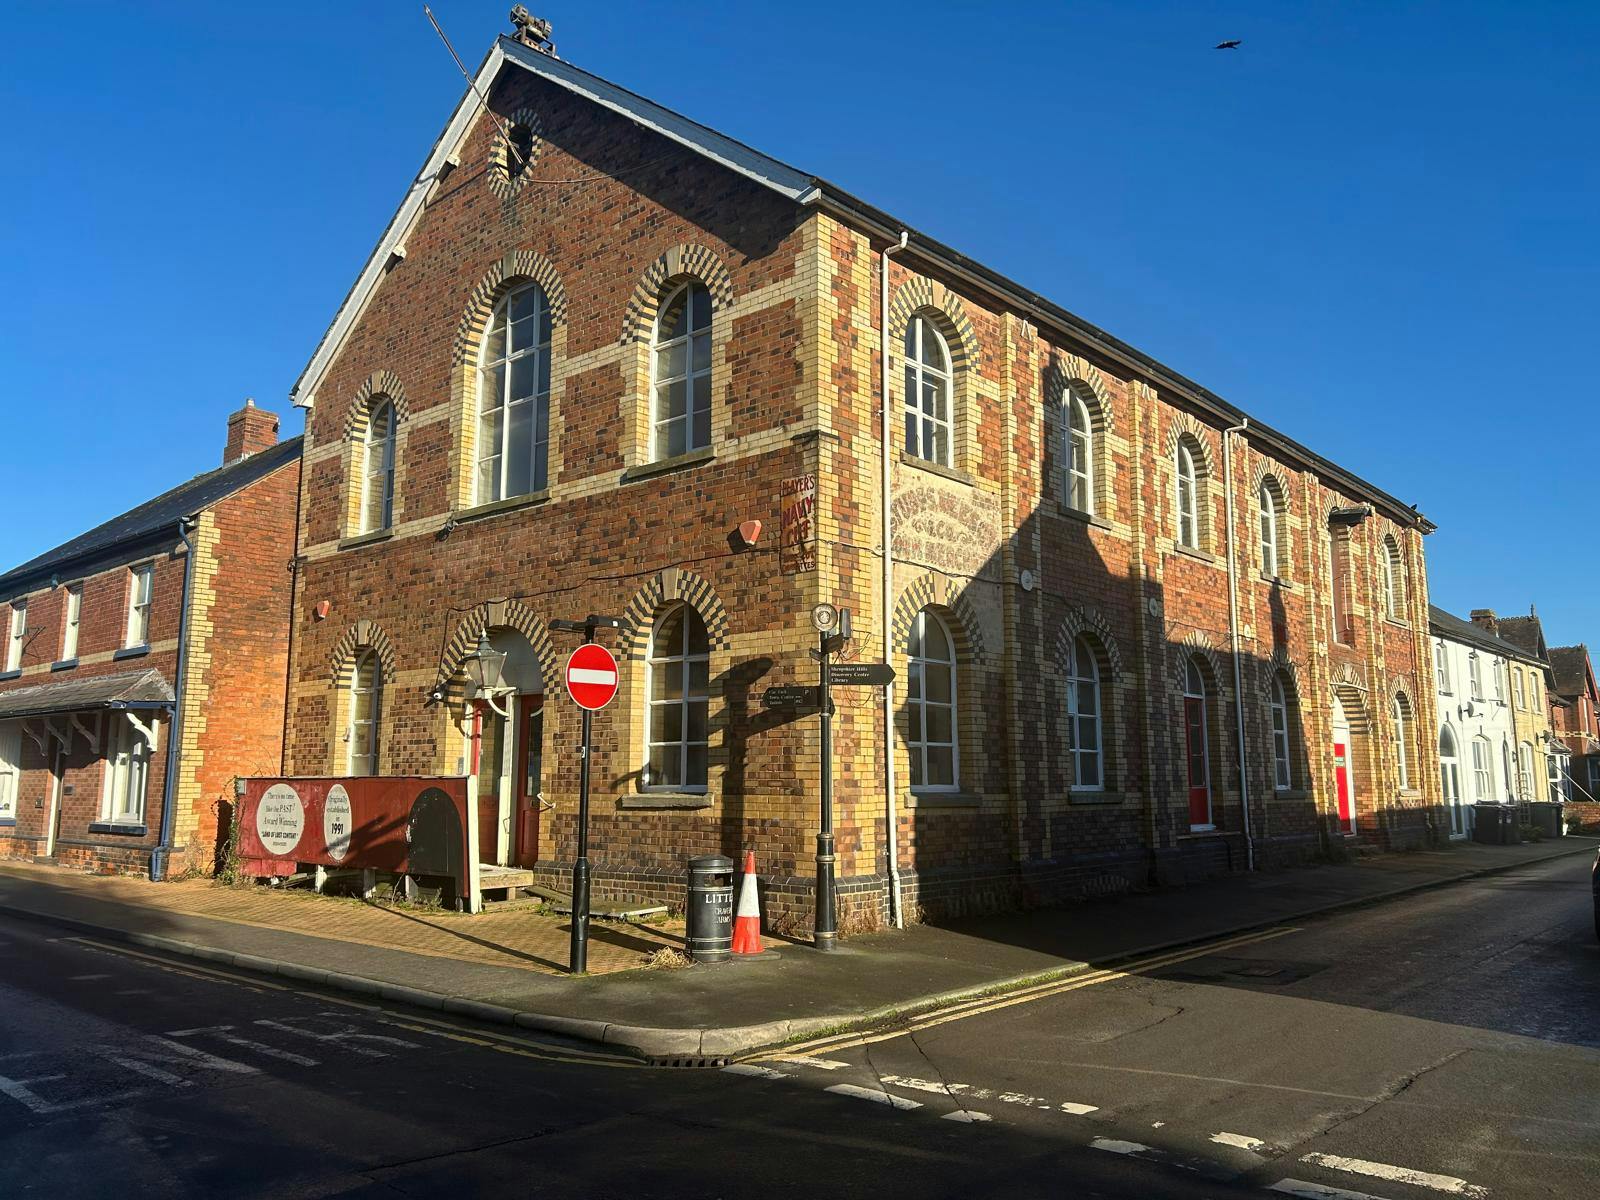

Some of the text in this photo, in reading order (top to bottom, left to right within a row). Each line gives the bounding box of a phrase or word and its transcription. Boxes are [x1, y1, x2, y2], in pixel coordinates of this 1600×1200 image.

[264, 817, 298, 827] Award Winning
[331, 822, 344, 834] 1991
[705, 893, 734, 904] LITTE
